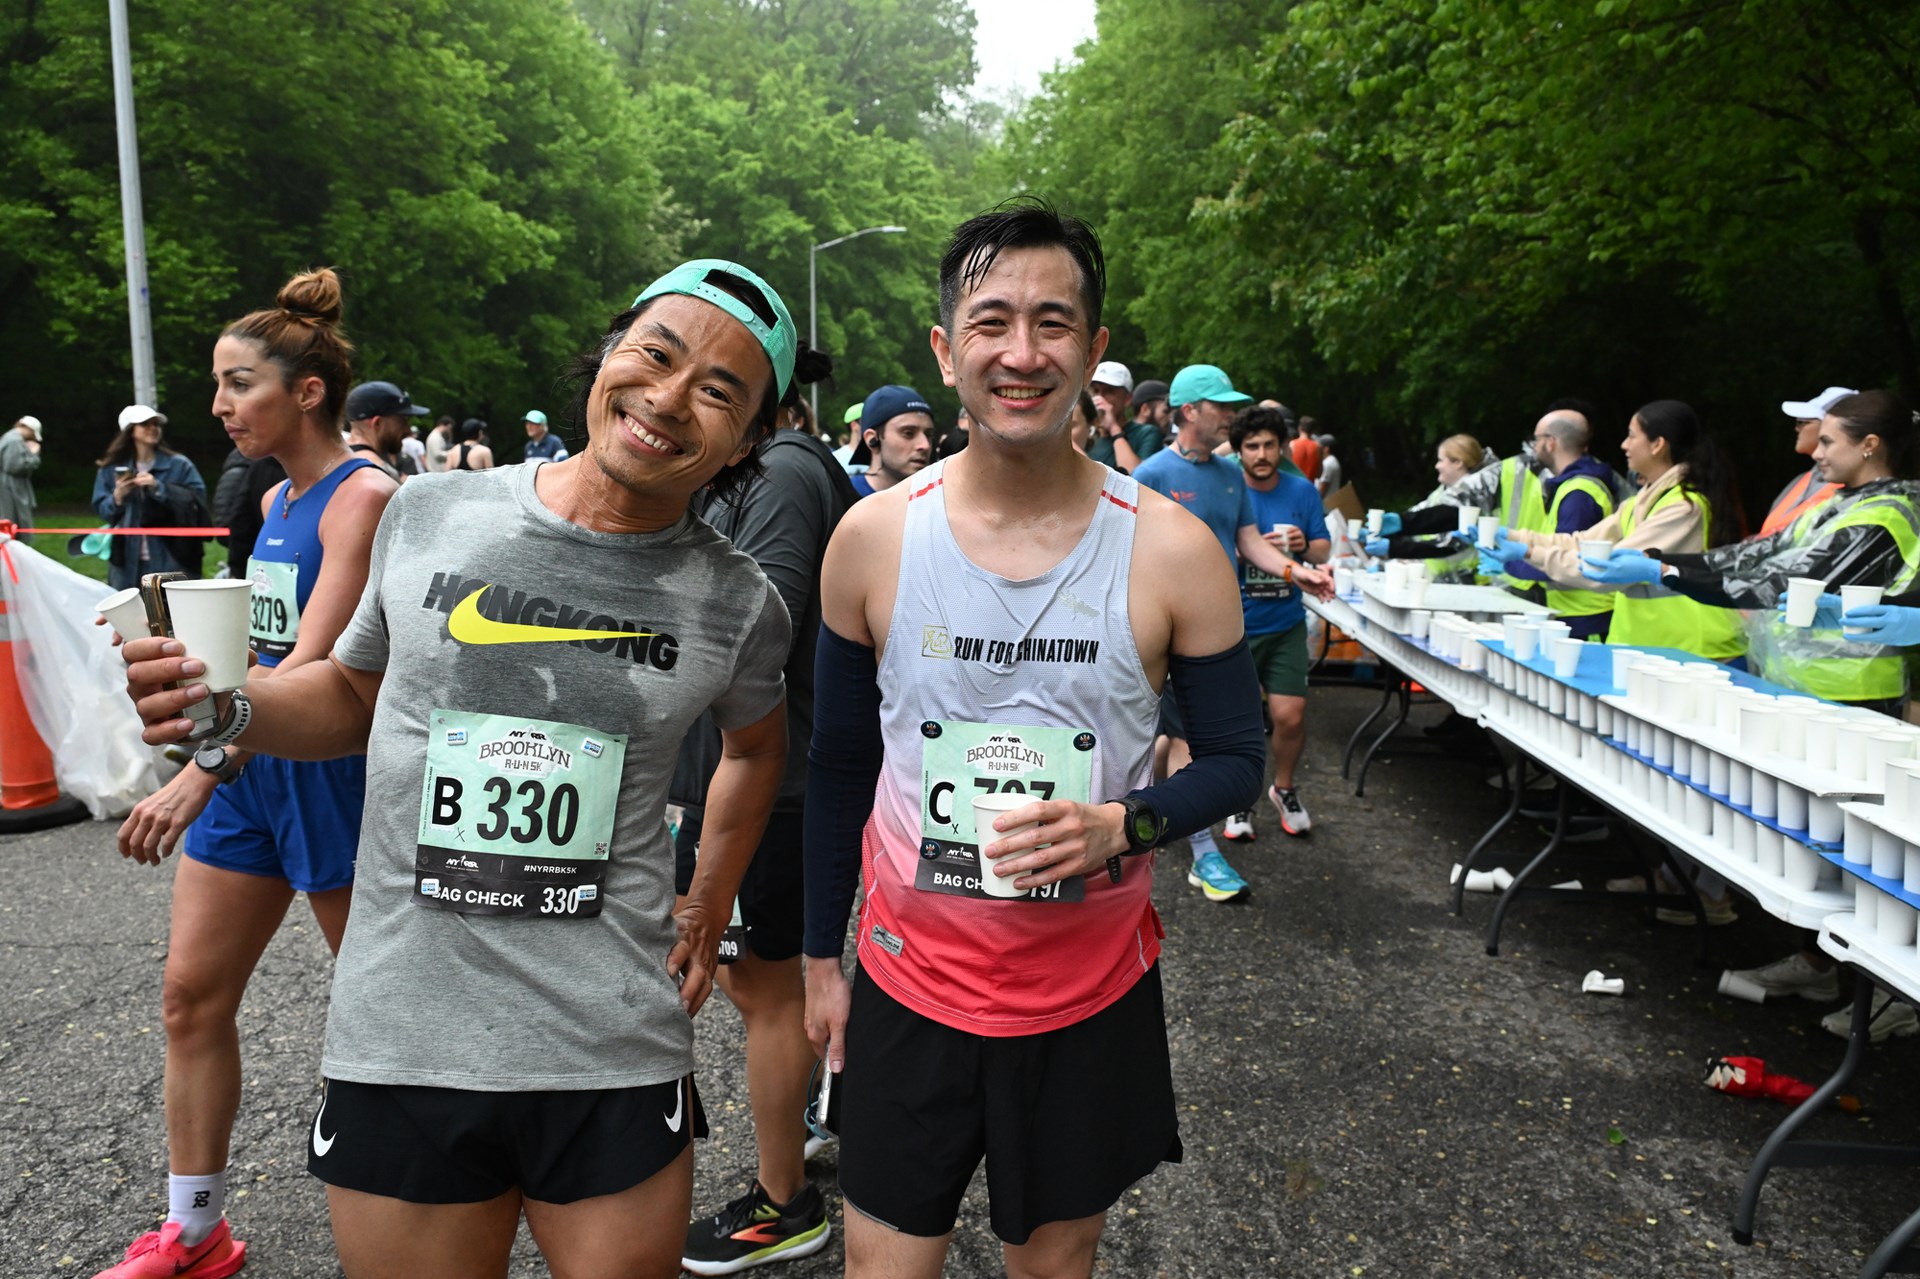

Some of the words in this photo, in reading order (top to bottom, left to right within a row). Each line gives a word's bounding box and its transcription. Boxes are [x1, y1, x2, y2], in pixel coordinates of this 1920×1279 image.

[250, 593, 288, 635] 3279
[954, 636, 984, 661] RUN
[986, 640, 1015, 665] FOR
[1016, 638, 1099, 664] CHINATOWN
[479, 740, 572, 768] BROOKLYN
[966, 745, 1044, 768] BROOKLYN
[432, 776, 463, 826] B
[476, 776, 579, 846] 330
[929, 781, 956, 825] C
[524, 864, 577, 874] #NYRRBK5K
[933, 872, 962, 887] BAG
[432, 887, 461, 902] AG
[465, 890, 525, 907] CHECK
[540, 887, 579, 914] 330
